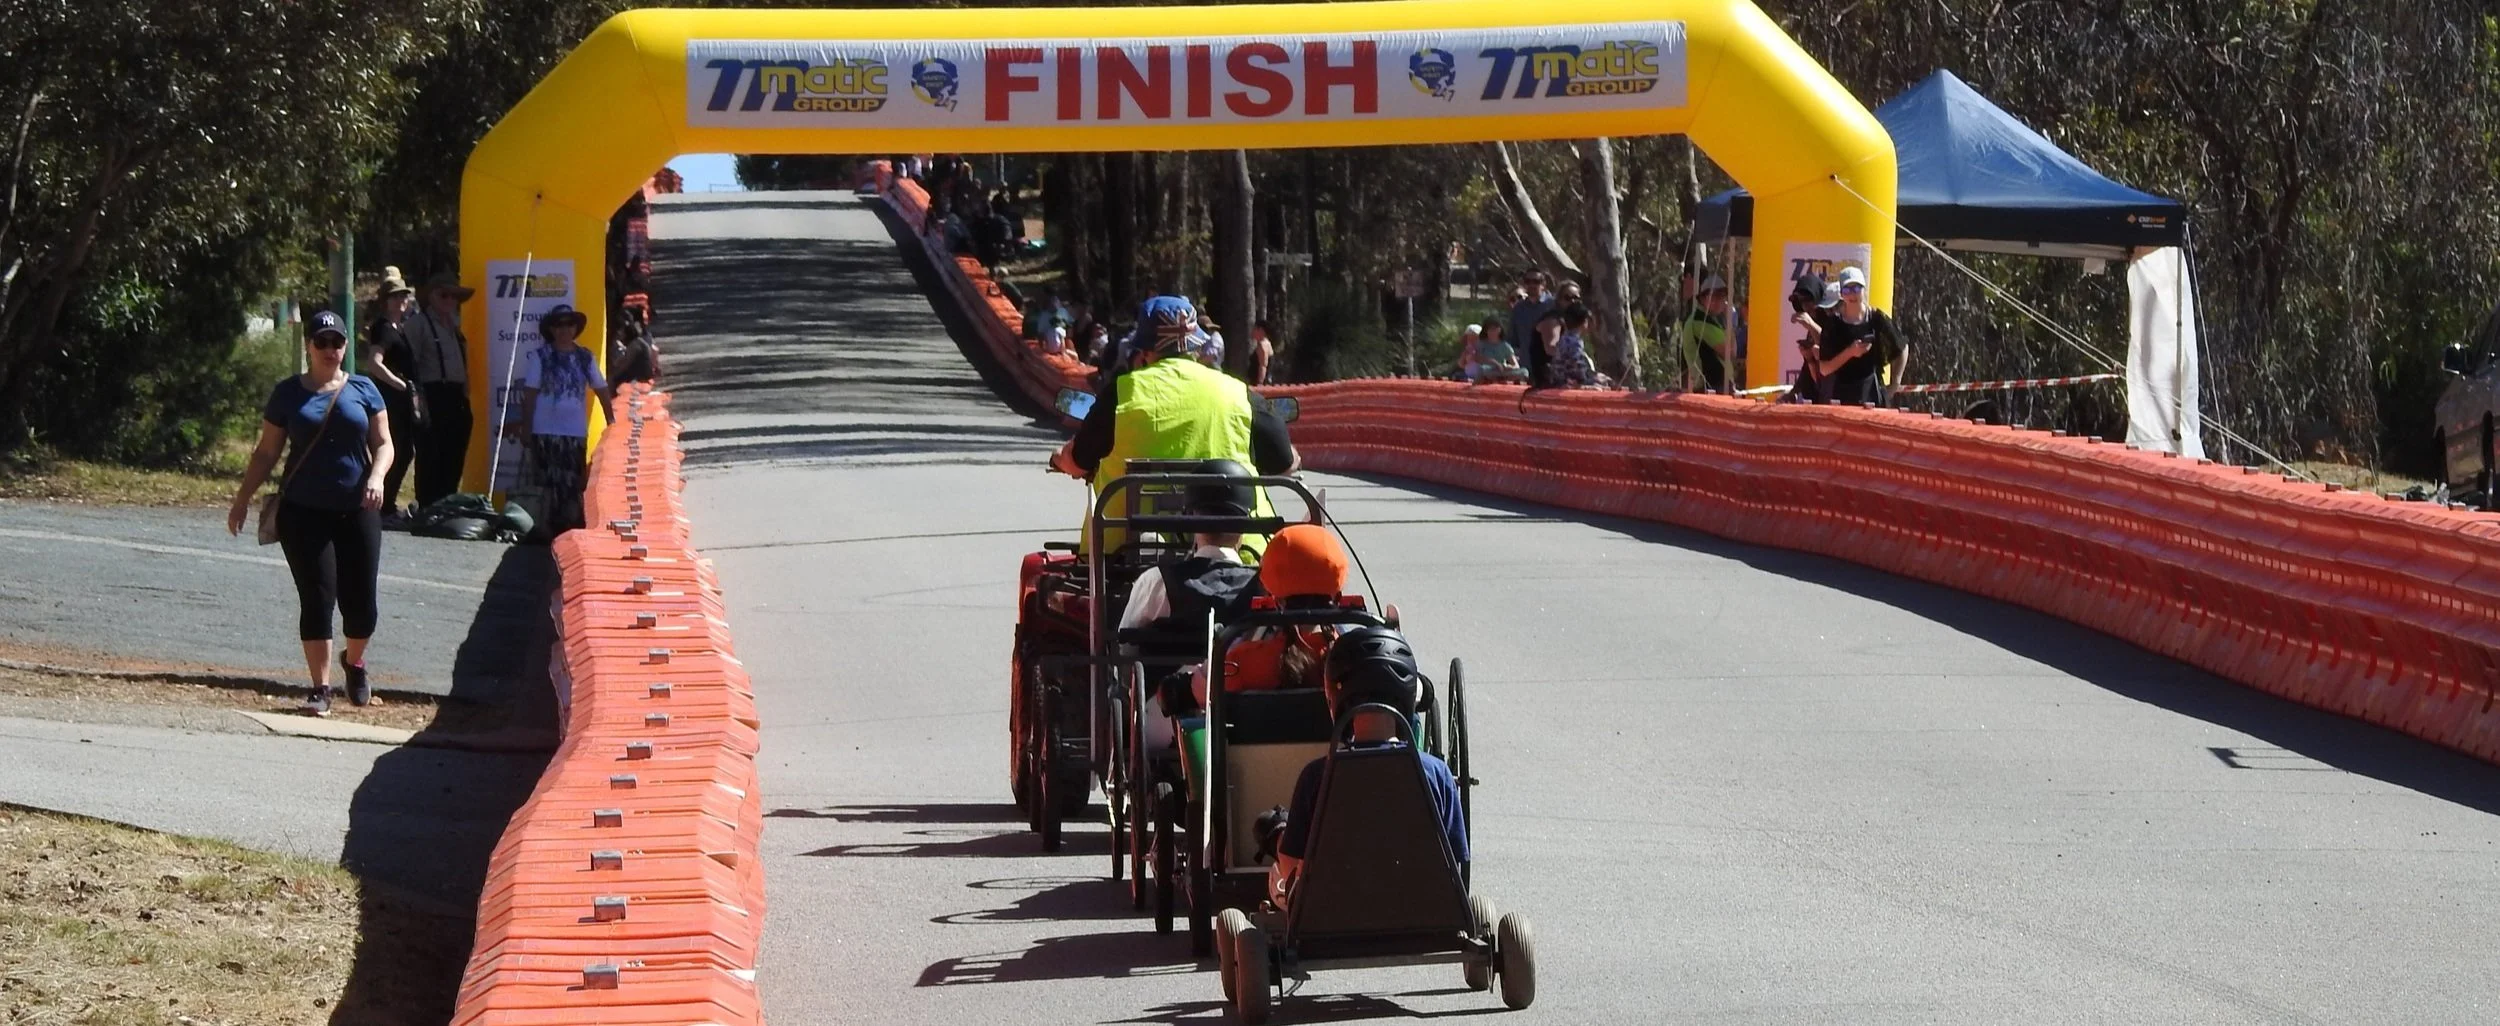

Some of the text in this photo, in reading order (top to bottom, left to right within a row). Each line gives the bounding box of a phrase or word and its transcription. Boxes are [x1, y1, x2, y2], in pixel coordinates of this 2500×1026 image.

[1533, 41, 1658, 79] matic
[761, 59, 888, 94] matic
[985, 41, 1378, 121] FINISH
[1566, 79, 1651, 96] GROUP
[793, 98, 880, 112] GROUP
[513, 311, 551, 323] Prou
